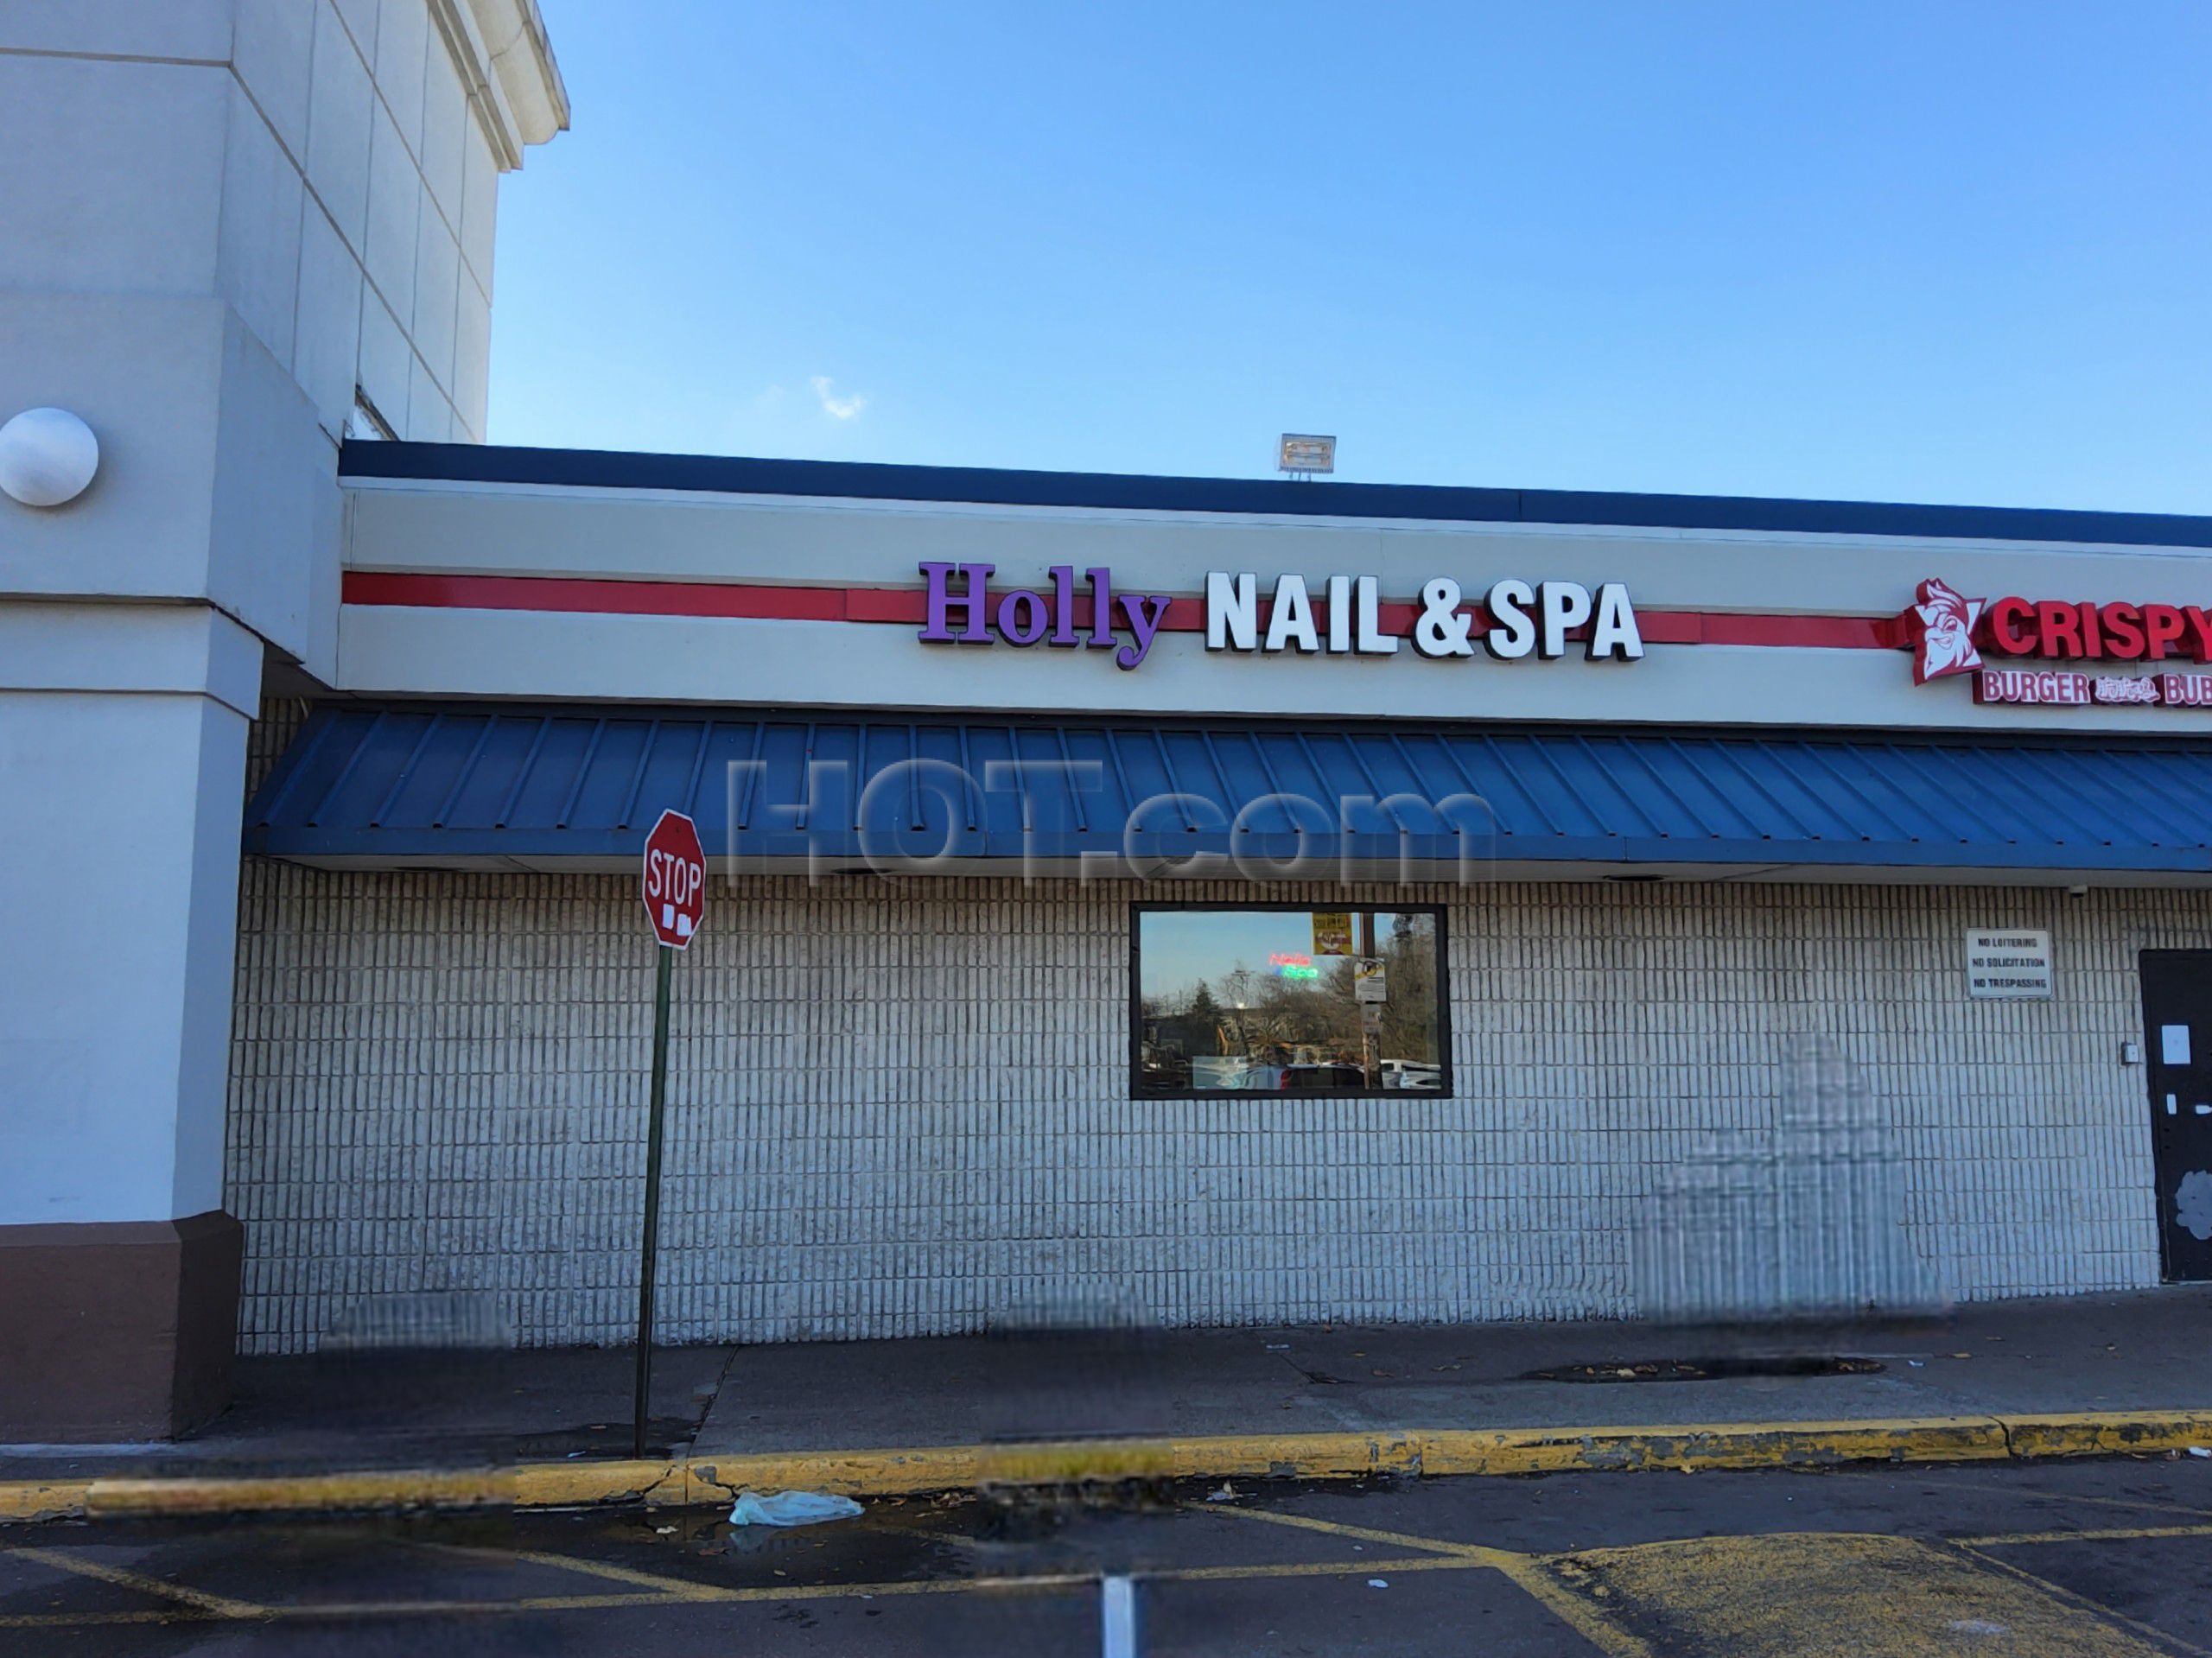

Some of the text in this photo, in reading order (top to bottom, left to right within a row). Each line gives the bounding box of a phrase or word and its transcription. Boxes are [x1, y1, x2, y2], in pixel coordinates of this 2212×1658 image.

[918, 562, 1172, 671] Holly
[1205, 570, 1398, 654] NAIL
[1484, 579, 1645, 662] SPA
[1981, 670, 2091, 704] BURGER
[649, 848, 702, 907] STOP
[1978, 937, 2037, 948] NO LOITERING
[1972, 957, 2045, 968] NO SOLICITATION
[1974, 978, 2047, 988] NO TRESPASSING
